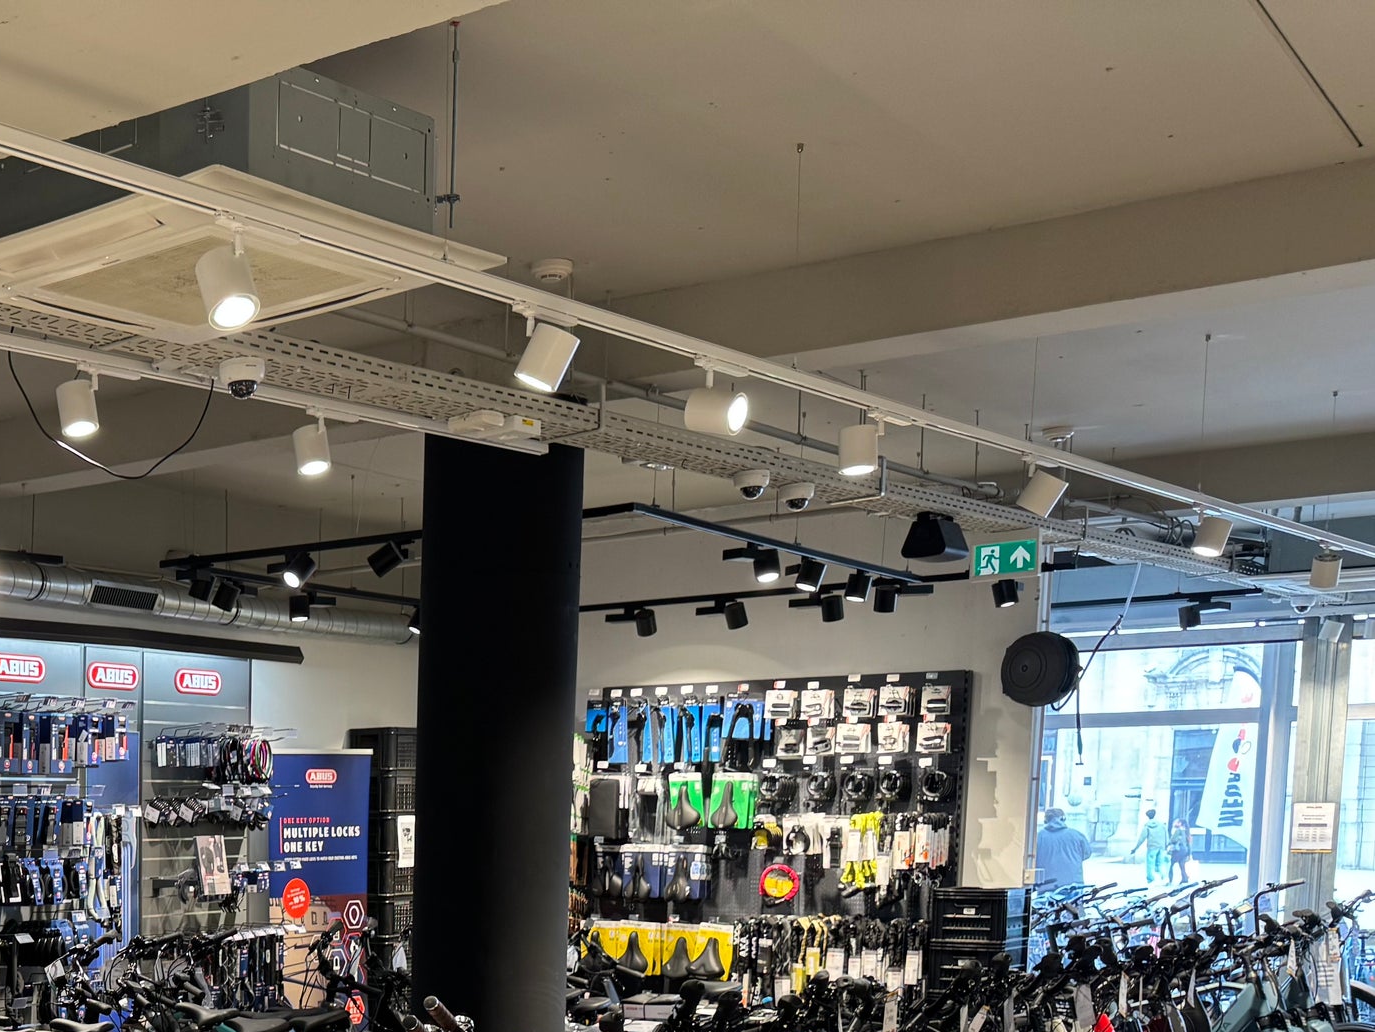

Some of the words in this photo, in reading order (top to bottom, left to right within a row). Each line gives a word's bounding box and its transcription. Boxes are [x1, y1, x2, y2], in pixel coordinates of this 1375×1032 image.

[95, 667, 134, 685] ABUS
[182, 673, 218, 690] ABUS
[309, 772, 334, 781] ABUS
[283, 826, 329, 839] MULTIPLE
[331, 825, 361, 838] LOCKS
[283, 841, 303, 853] ONE
[305, 840, 324, 852] KEY
